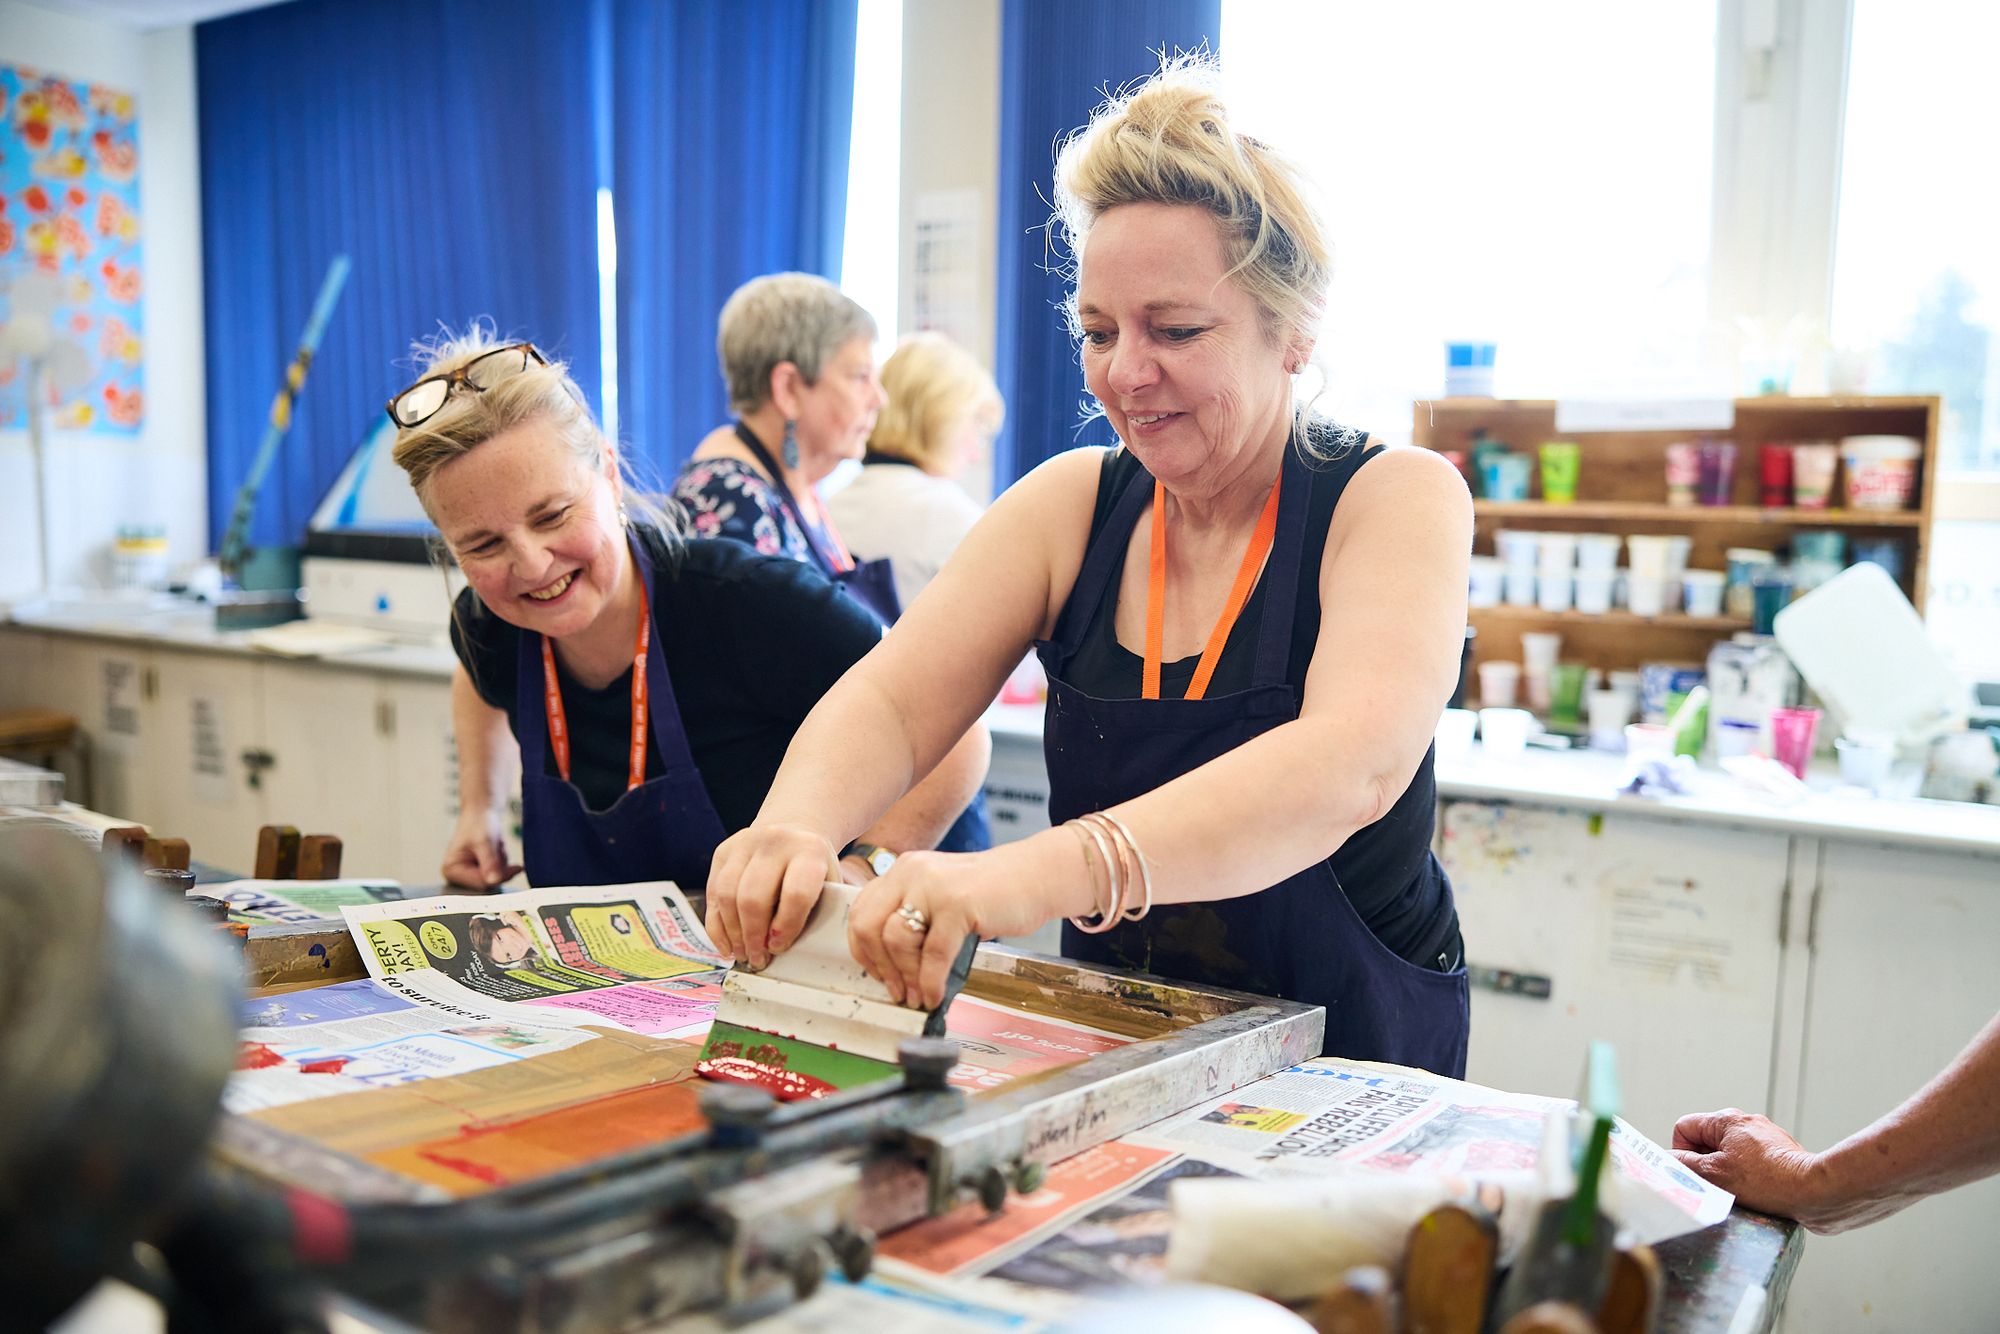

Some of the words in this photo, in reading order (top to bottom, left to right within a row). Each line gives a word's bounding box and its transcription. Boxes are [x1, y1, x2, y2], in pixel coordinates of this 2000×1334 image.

[430, 926, 452, 953] 24/7
[400, 988, 471, 1015] survive
[1342, 1094, 1429, 1136] RATCLIFFE
